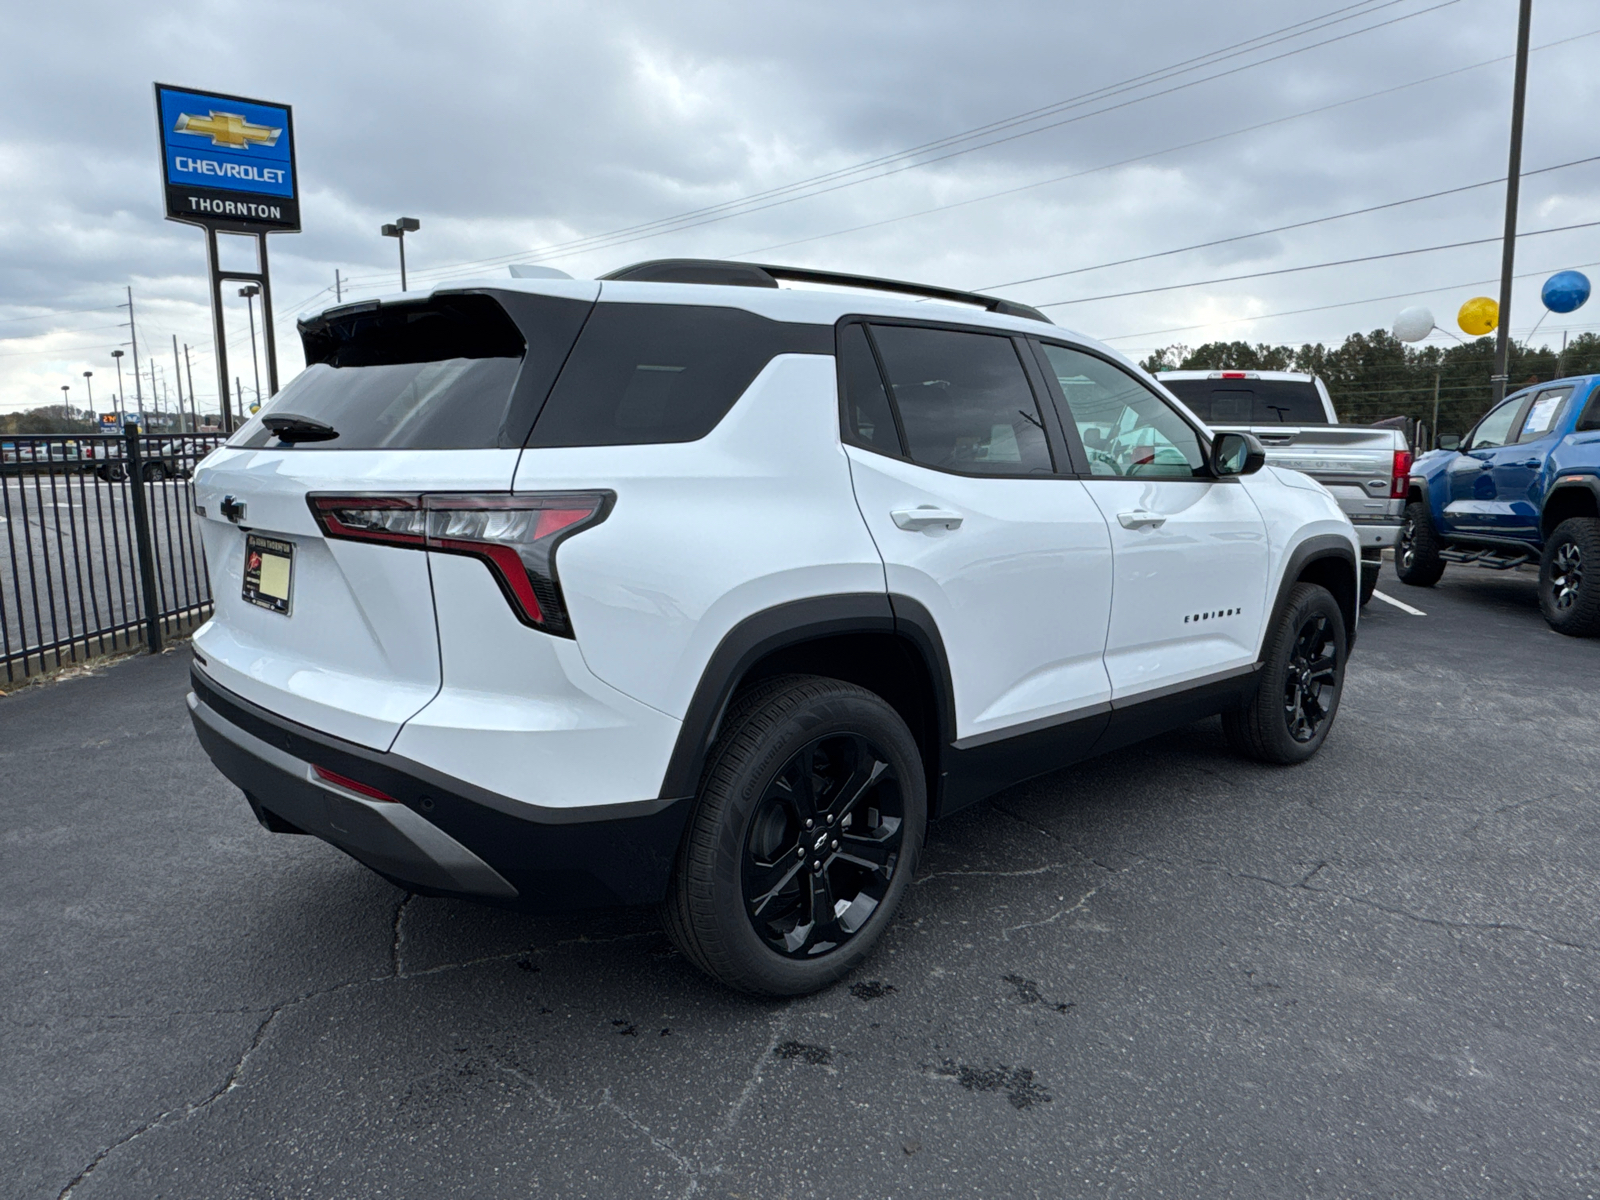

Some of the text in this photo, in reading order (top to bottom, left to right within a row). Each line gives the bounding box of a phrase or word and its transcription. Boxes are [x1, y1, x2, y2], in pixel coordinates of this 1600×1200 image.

[175, 156, 285, 184] CHEVROLET
[188, 196, 281, 219] THORNTON
[1184, 607, 1241, 623] EQUINOX
[741, 734, 788, 802] Continental
